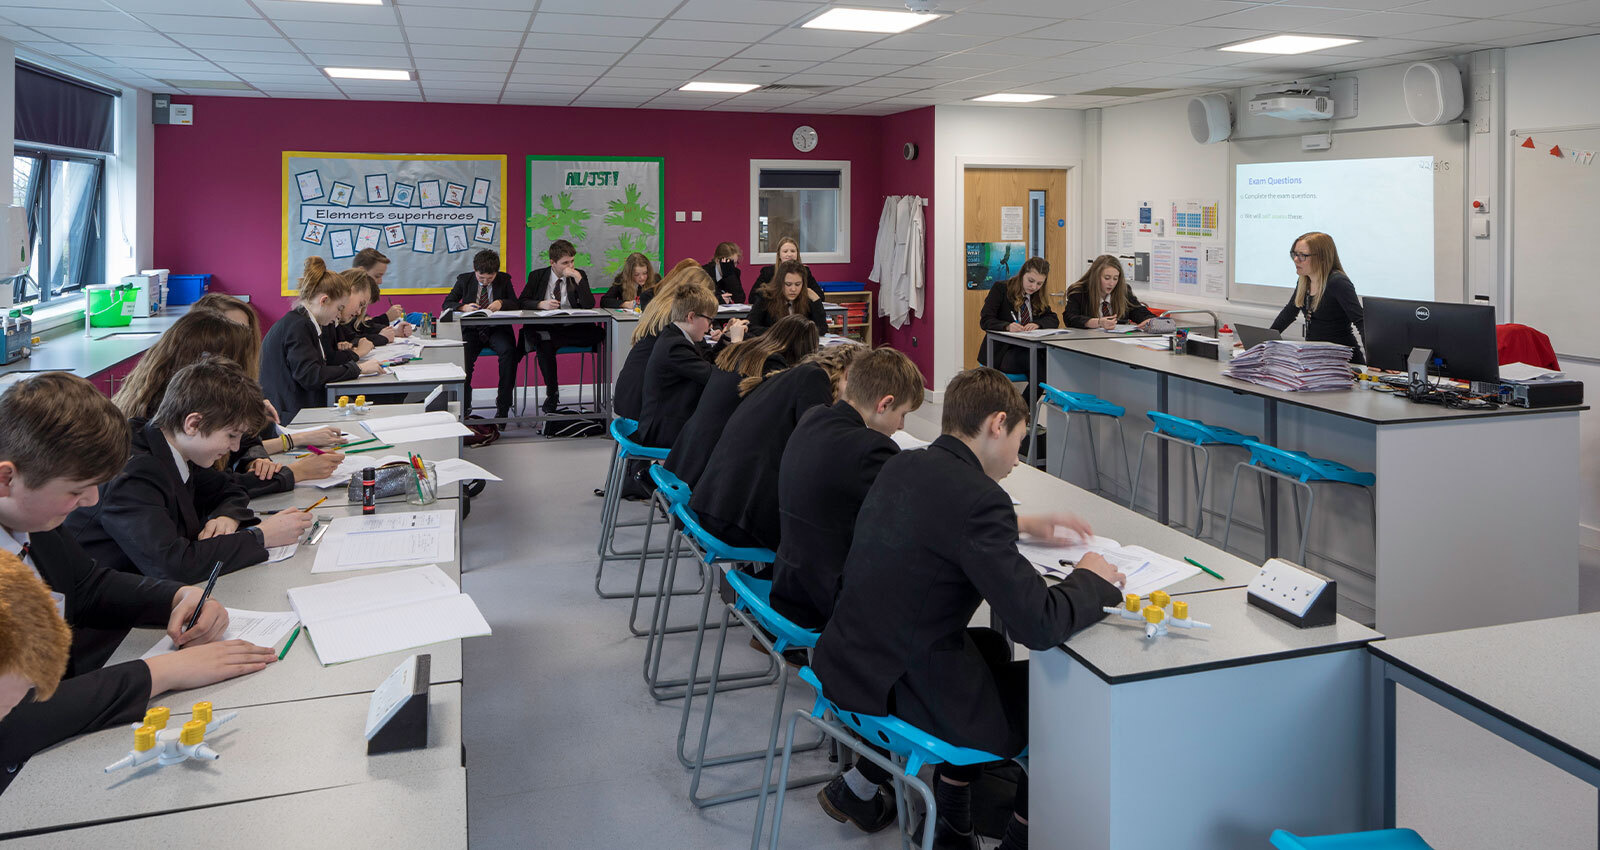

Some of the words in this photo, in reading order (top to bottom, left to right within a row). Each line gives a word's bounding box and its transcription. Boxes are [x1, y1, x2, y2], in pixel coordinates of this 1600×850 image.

[1248, 177, 1267, 185] Exam
[1267, 176, 1302, 185] Questions
[316, 209, 385, 219] Elements
[388, 210, 474, 222] superheroes
